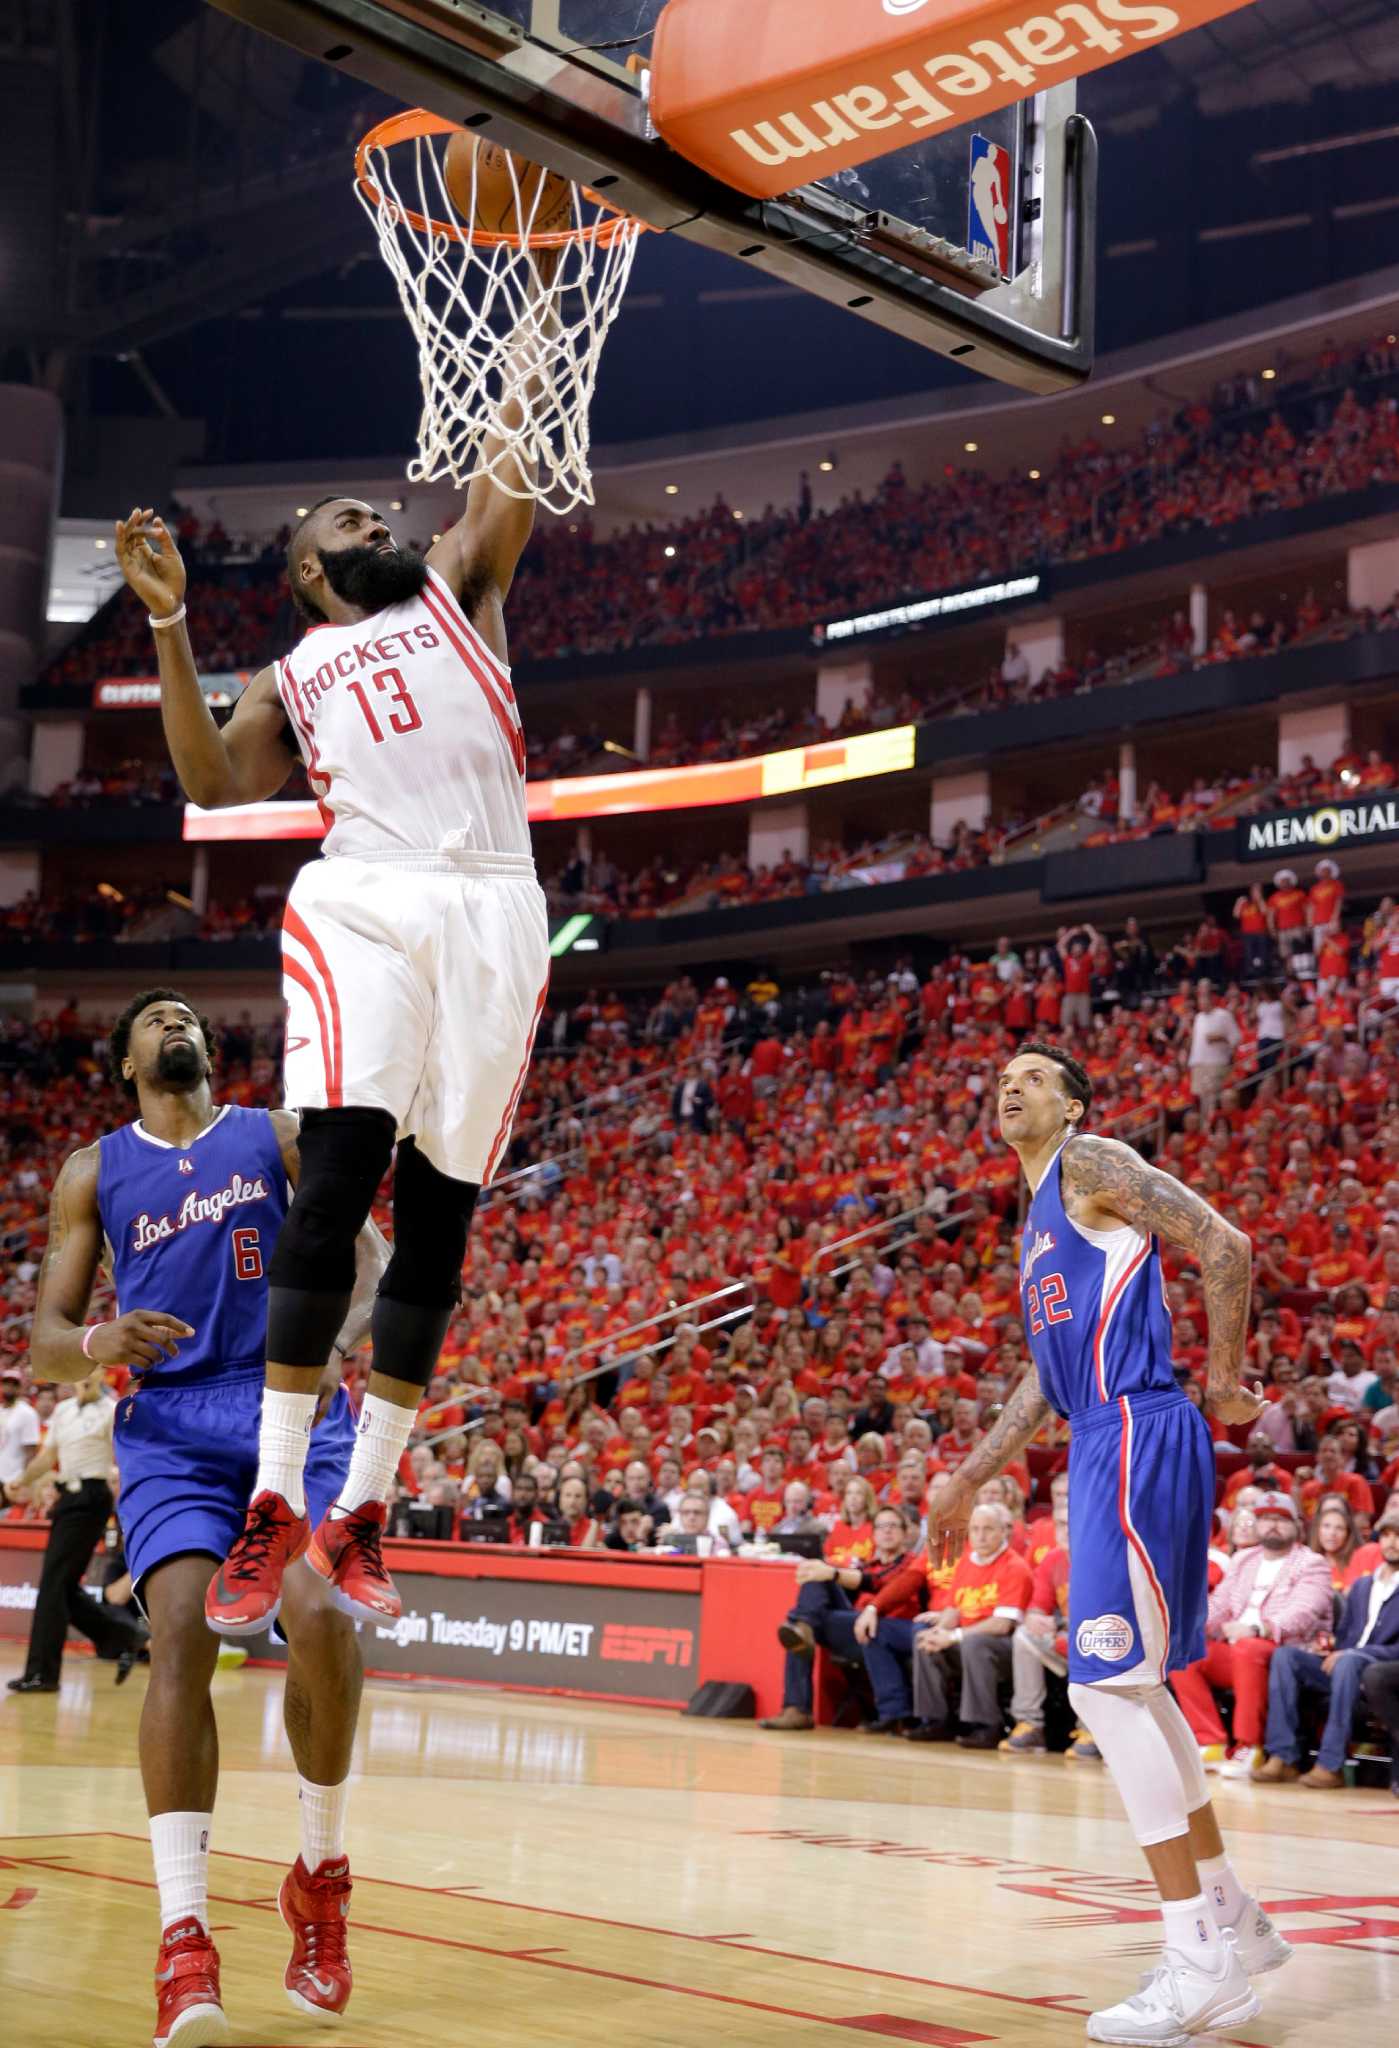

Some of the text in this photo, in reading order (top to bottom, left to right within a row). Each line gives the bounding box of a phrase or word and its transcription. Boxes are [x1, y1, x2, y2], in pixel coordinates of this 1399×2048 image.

[300, 624, 440, 712] ROCKETS
[345, 667, 424, 744] 13
[1248, 802, 1399, 851] MEMORIAL
[134, 1174, 268, 1251] Los Angeles
[231, 1227, 263, 1281] 6
[1028, 1272, 1073, 1336] 22
[431, 1612, 508, 1655] Tuesday
[509, 1619, 526, 1651] 9
[527, 1620, 595, 1657] PM/ET
[600, 1622, 694, 1667] ESPN
[731, 1829, 1161, 1893] HOUSTO
